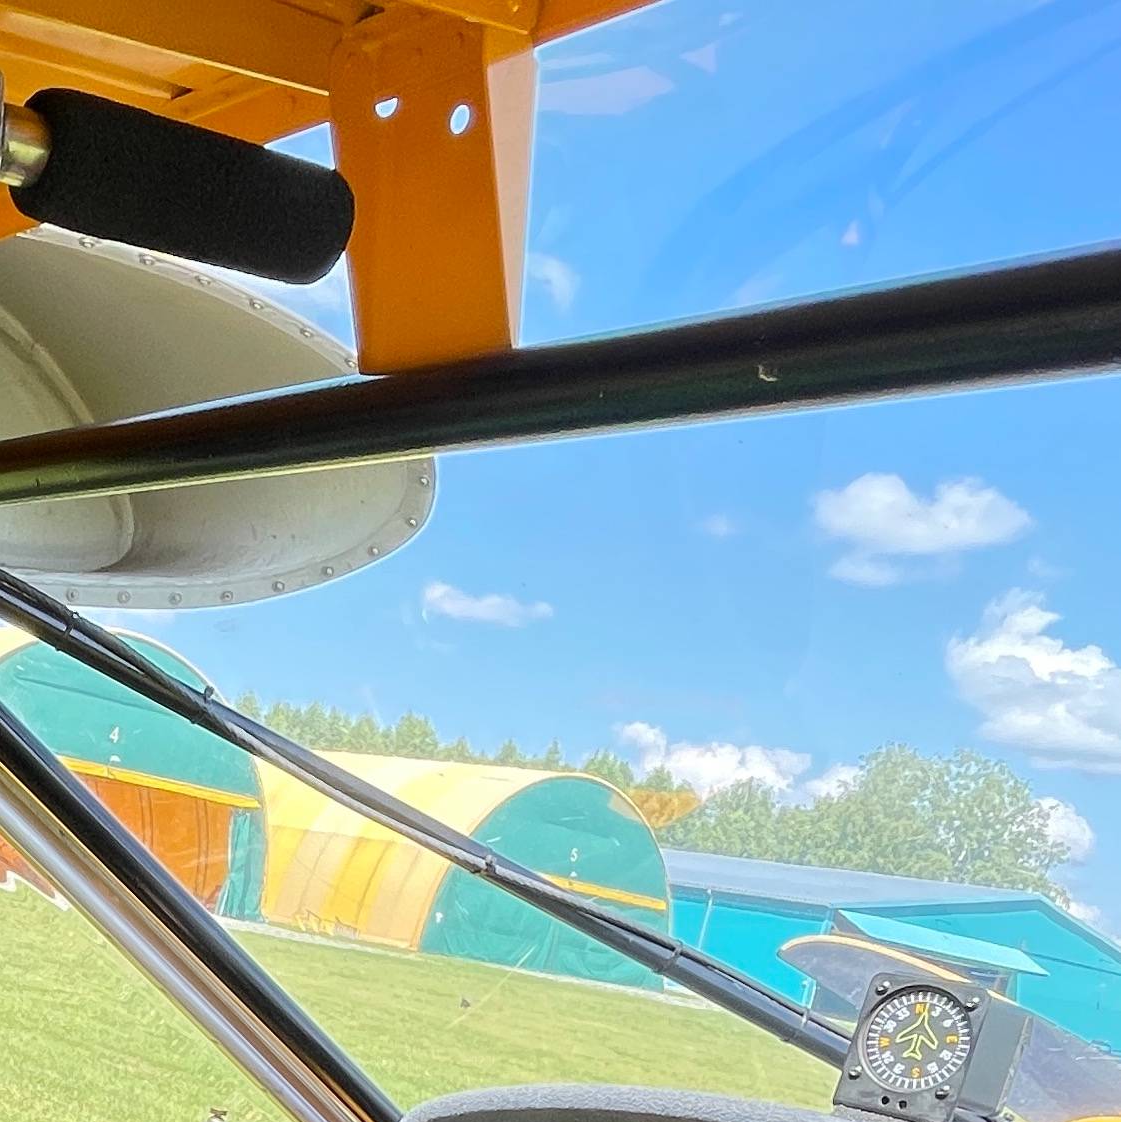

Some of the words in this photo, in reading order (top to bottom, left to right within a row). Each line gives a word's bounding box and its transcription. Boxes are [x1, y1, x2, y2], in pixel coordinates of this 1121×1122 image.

[109, 726, 120, 744] 4
[570, 847, 579, 862] 5
[896, 1009, 910, 1020] 33
